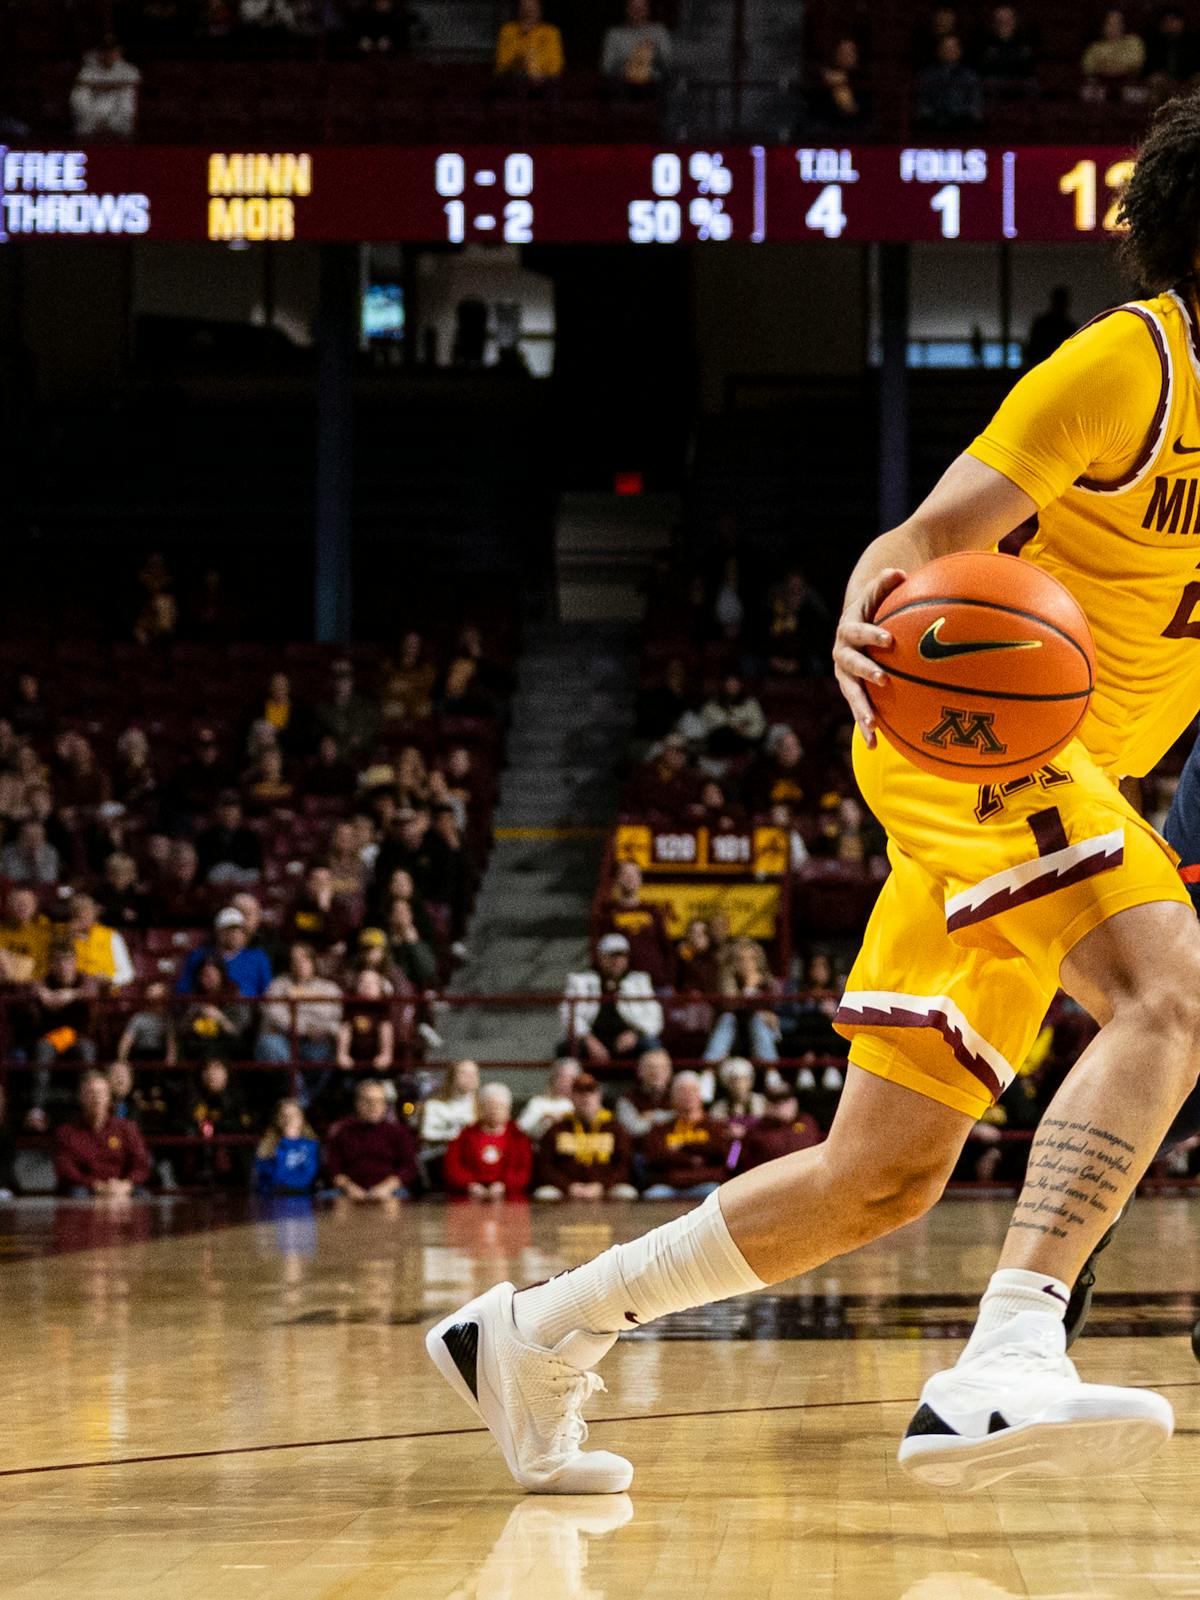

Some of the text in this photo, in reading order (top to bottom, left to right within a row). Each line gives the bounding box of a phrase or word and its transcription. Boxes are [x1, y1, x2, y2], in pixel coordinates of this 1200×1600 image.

[4, 151, 88, 192] FREE
[208, 152, 312, 196] MINN
[899, 148, 987, 182] FOULS
[3, 195, 150, 234] THROWS
[208, 197, 295, 242] MOR
[805, 184, 847, 239] 4
[930, 184, 961, 239] 1
[1078, 1165, 1106, 1183] God
